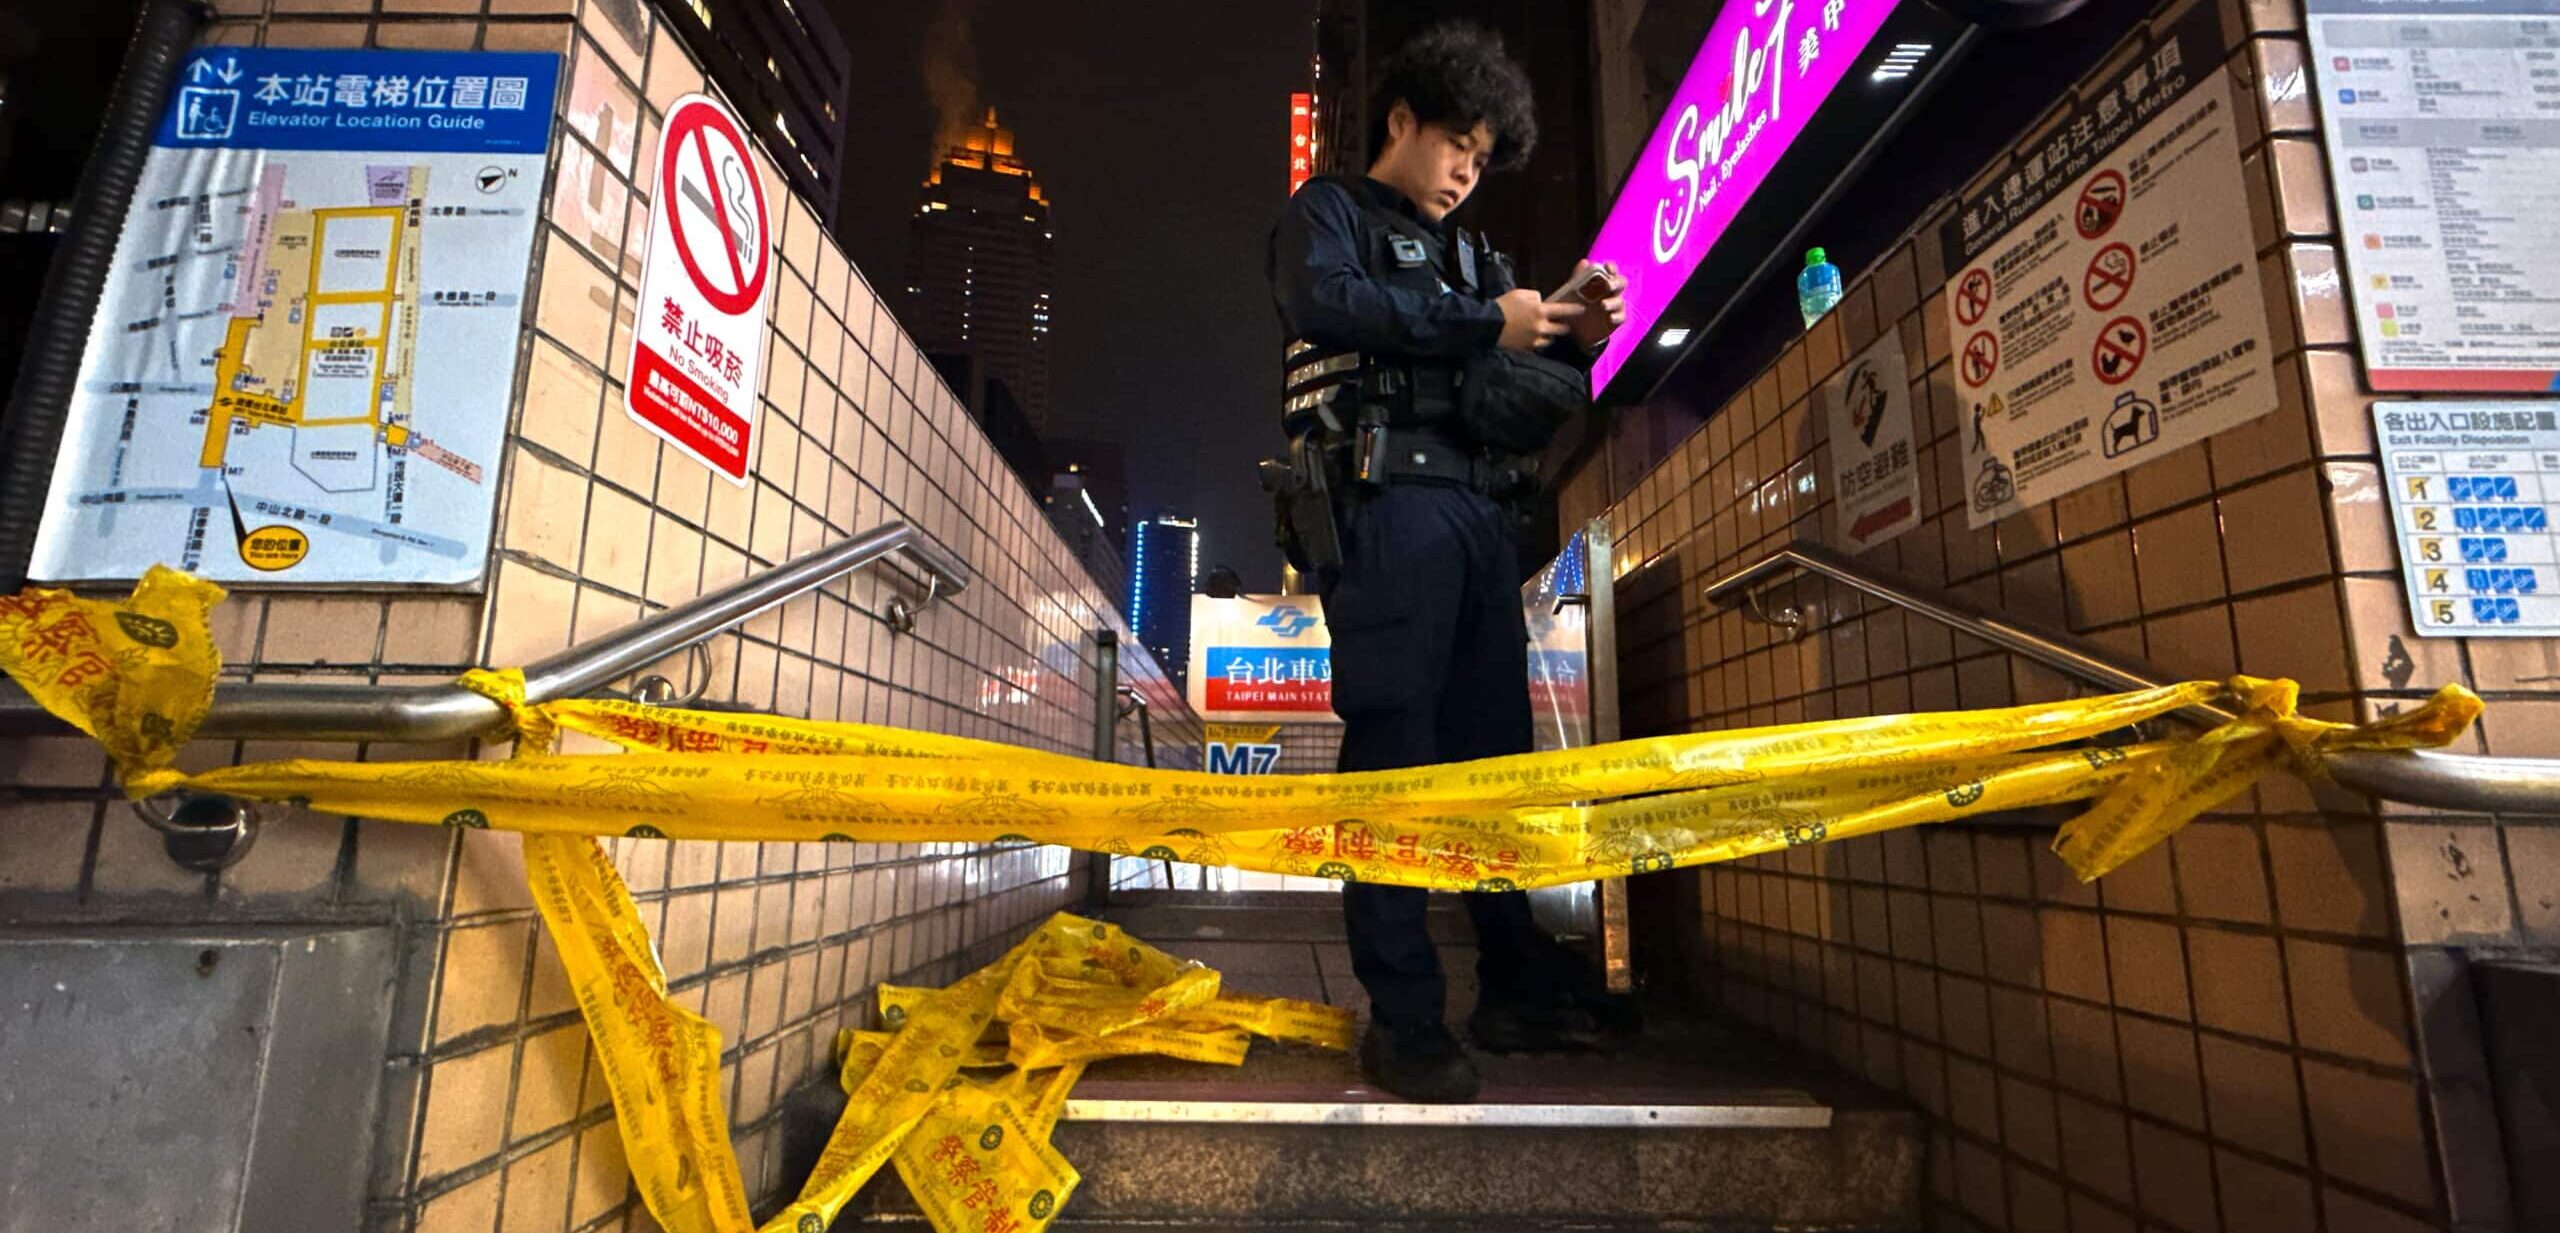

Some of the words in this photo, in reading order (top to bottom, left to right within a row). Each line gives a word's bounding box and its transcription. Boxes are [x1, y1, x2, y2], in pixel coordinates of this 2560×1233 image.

[253, 72, 529, 111] 本站電梯位置圖
[248, 112, 329, 128] Elevator
[335, 113, 421, 129] Location
[422, 113, 485, 131] Guide
[1962, 36, 2183, 241] 進入捷運站注意事項
[2009, 189, 2042, 223] Rules
[2045, 170, 2064, 192] for
[2065, 152, 2089, 177] the
[2135, 74, 2186, 117] Metro
[508, 168, 518, 177] N
[661, 296, 744, 390] 禁止吸菸
[669, 344, 685, 367] No
[687, 359, 729, 404] Smoking
[2384, 411, 2558, 431] 各出入口設施配置
[2389, 434, 2413, 445] Exit
[2415, 434, 2459, 447] Facility
[2461, 434, 2530, 447] Disposition
[228, 467, 244, 476] M7
[1839, 437, 1911, 498] 防空避難
[2414, 481, 2428, 500] 1
[2419, 511, 2436, 531] 2
[2426, 542, 2443, 562] 3
[2432, 572, 2449, 593] 4
[2438, 604, 2455, 625] 5
[1226, 691, 1264, 702] TAIPEI
[1267, 691, 1297, 702] MAIN
[1210, 744, 1278, 775] M7
